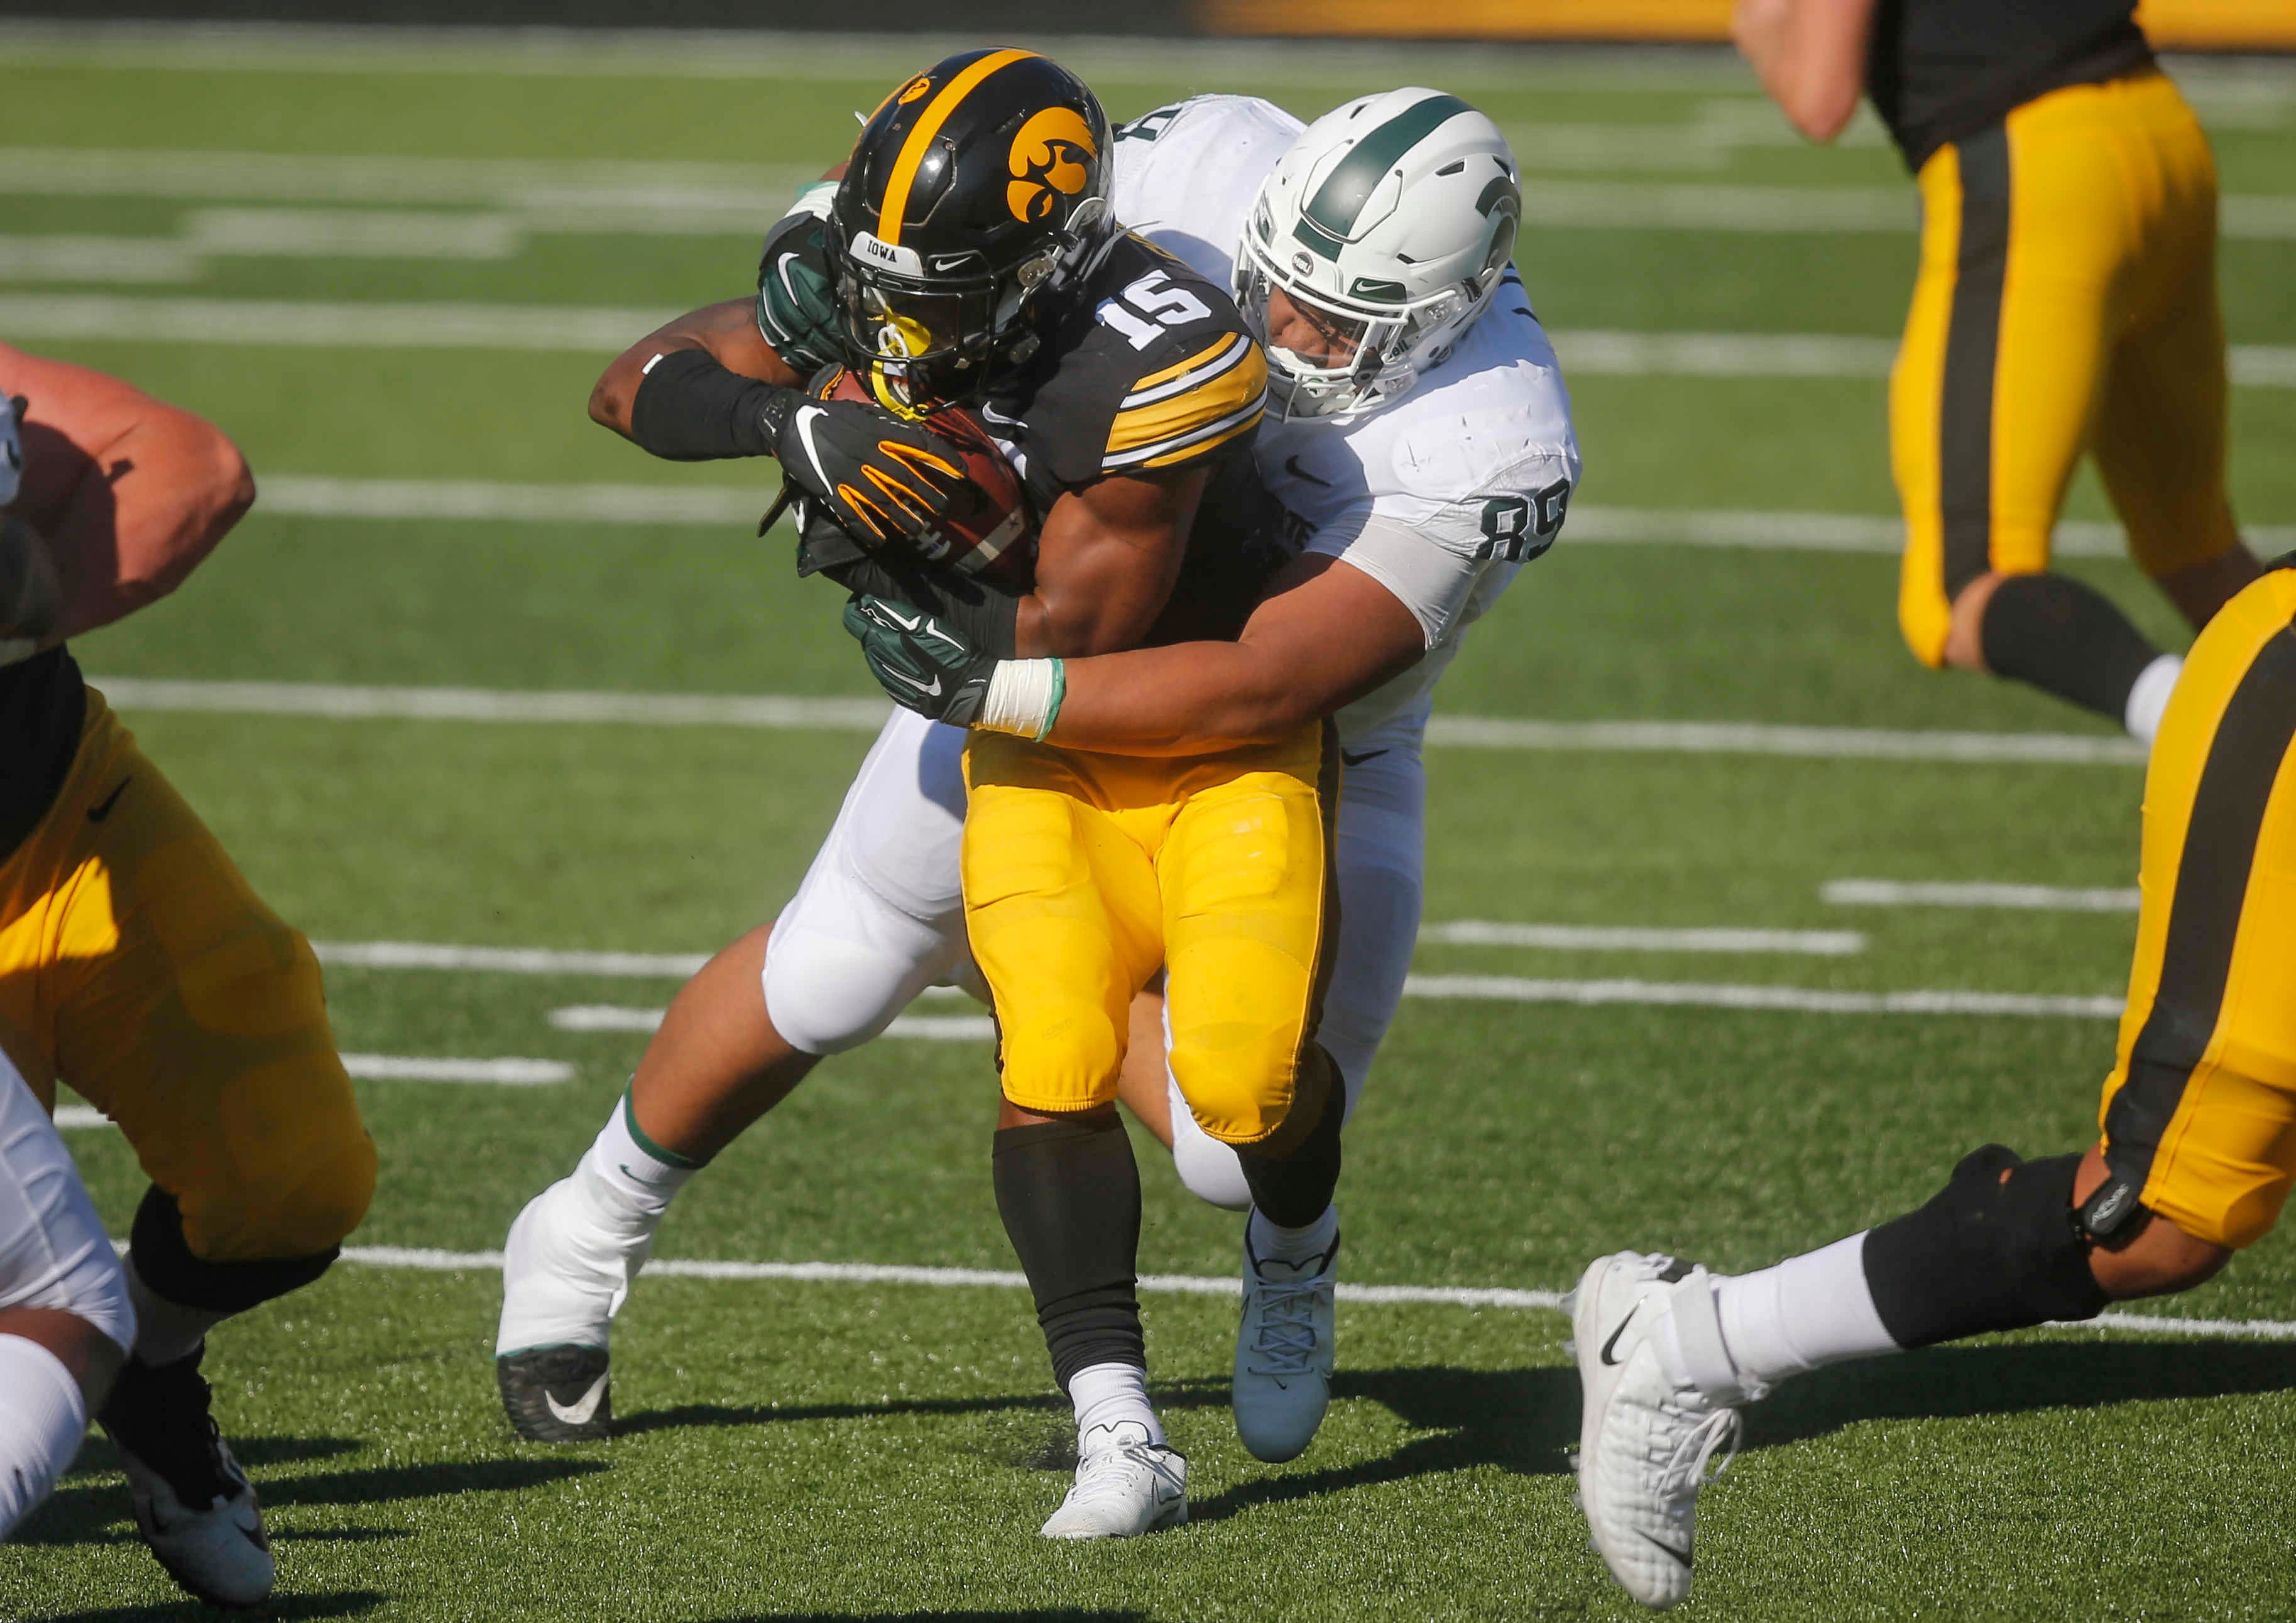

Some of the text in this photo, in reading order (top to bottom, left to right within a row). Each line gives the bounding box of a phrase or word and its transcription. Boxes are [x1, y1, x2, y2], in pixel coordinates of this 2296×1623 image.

[867, 240, 897, 263] IOWA
[1095, 269, 1212, 351] 15
[1476, 478, 1570, 561] 89
